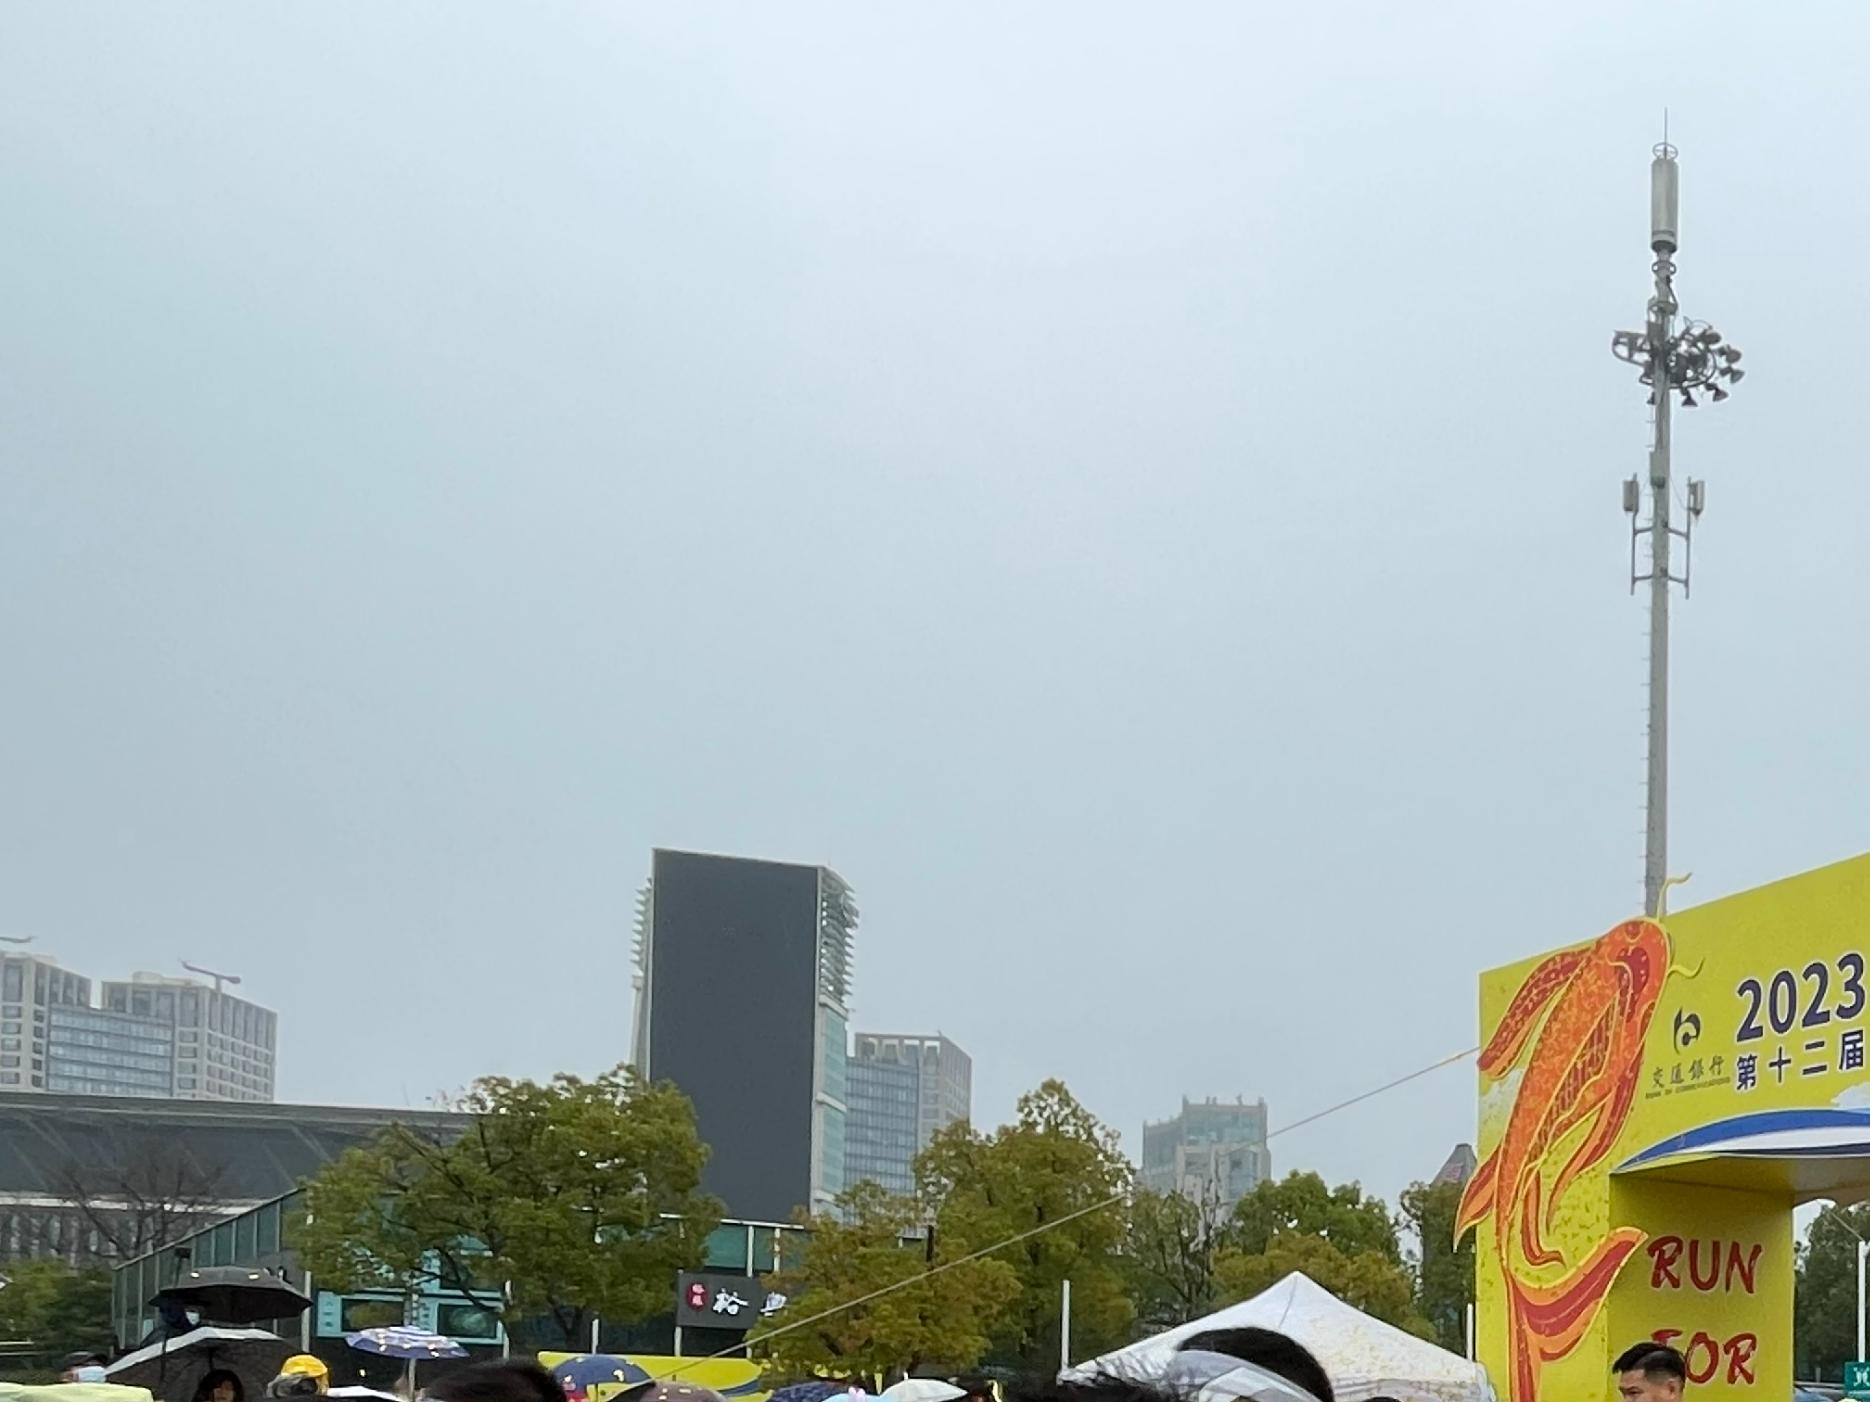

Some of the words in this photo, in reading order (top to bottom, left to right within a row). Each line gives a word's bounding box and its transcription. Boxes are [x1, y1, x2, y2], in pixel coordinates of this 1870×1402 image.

[1736, 1030, 1864, 1090] 第十二届
[1646, 1235, 1763, 1294] RUN
